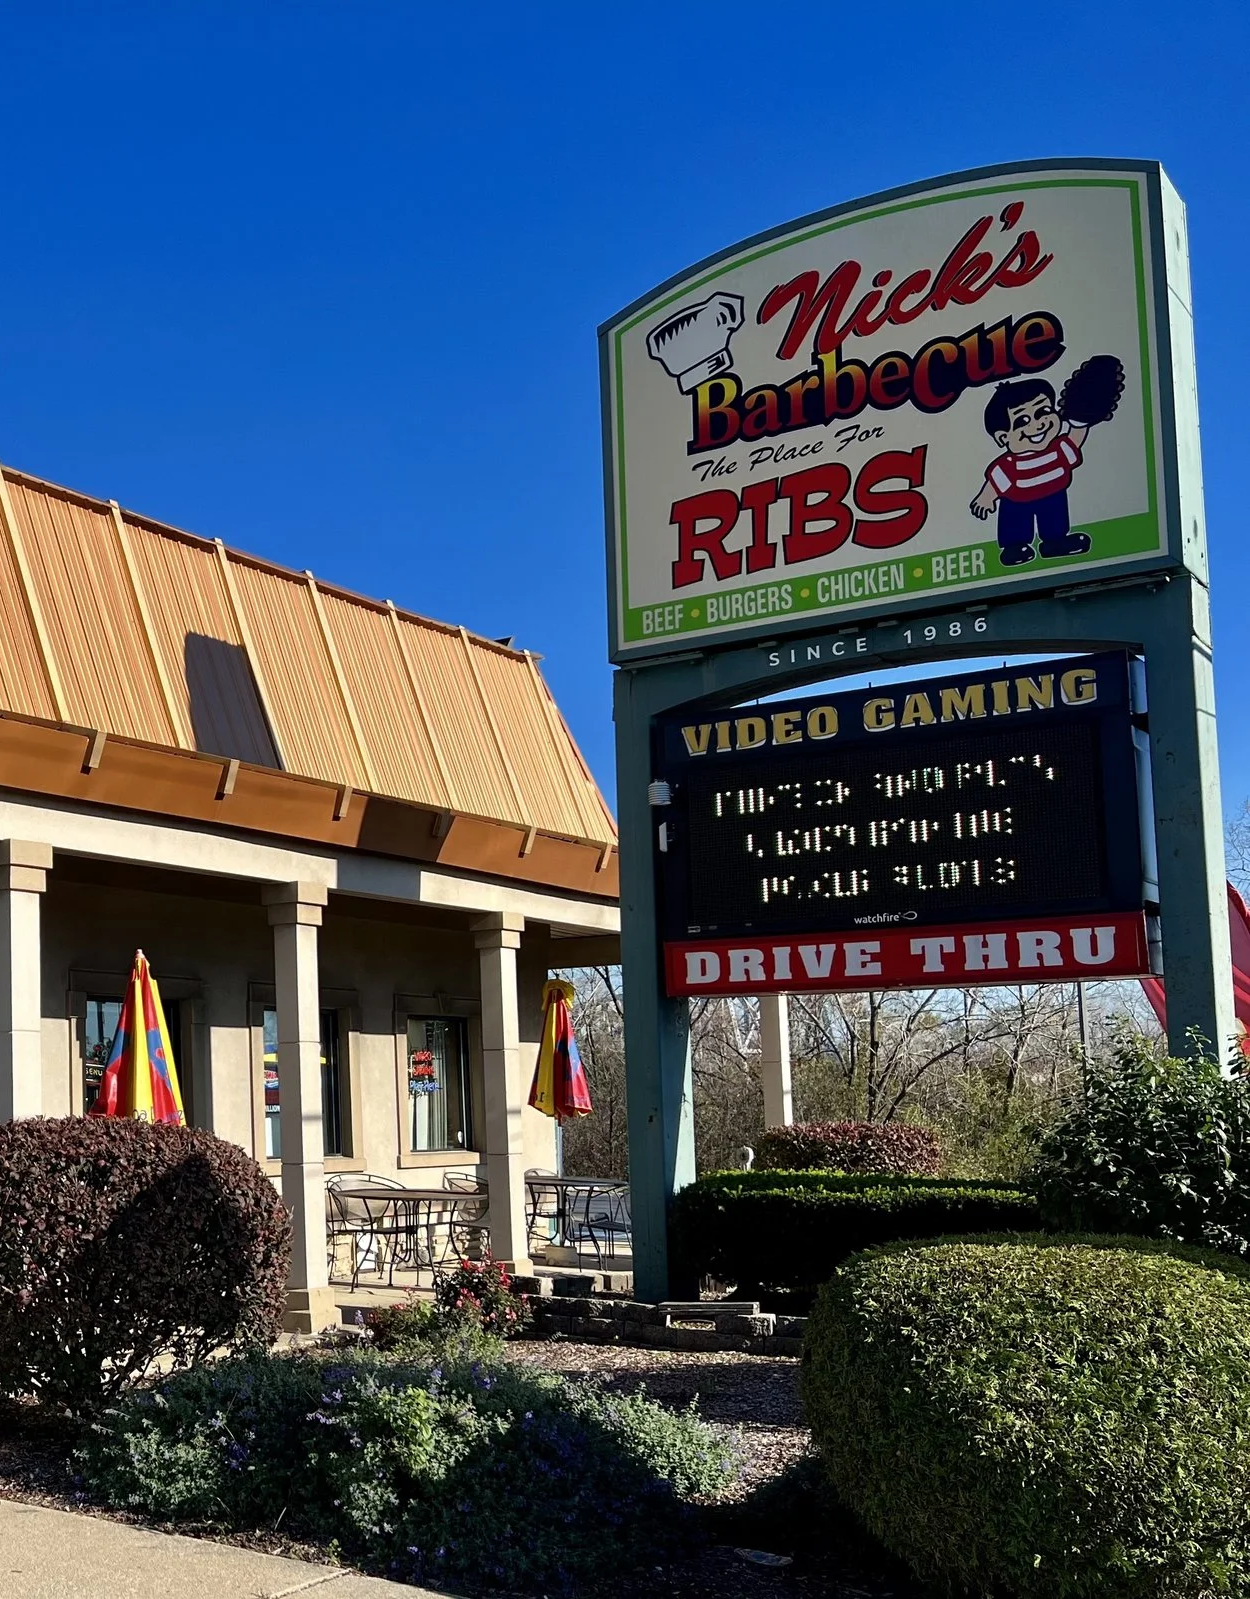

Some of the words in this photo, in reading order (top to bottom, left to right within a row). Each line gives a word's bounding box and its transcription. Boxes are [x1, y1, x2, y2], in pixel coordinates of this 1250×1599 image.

[756, 201, 1053, 360] Nick's
[687, 311, 1066, 456] Barbecue
[692, 456, 738, 482] The
[749, 440, 824, 471] Place
[834, 423, 885, 452] For
[669, 444, 929, 589] RIBS
[642, 604, 684, 635] BEEF
[706, 584, 793, 624] BURGERS
[816, 563, 905, 604] CHICKEN
[931, 548, 986, 583] BEER
[768, 637, 868, 666] SINCE
[903, 617, 987, 644] 1986
[681, 705, 839, 757] VIDEO
[862, 668, 1098, 733] GAMING
[684, 940, 882, 985] DRIVE
[909, 925, 1117, 974] THRU
[853, 912, 900, 924] watchfire
